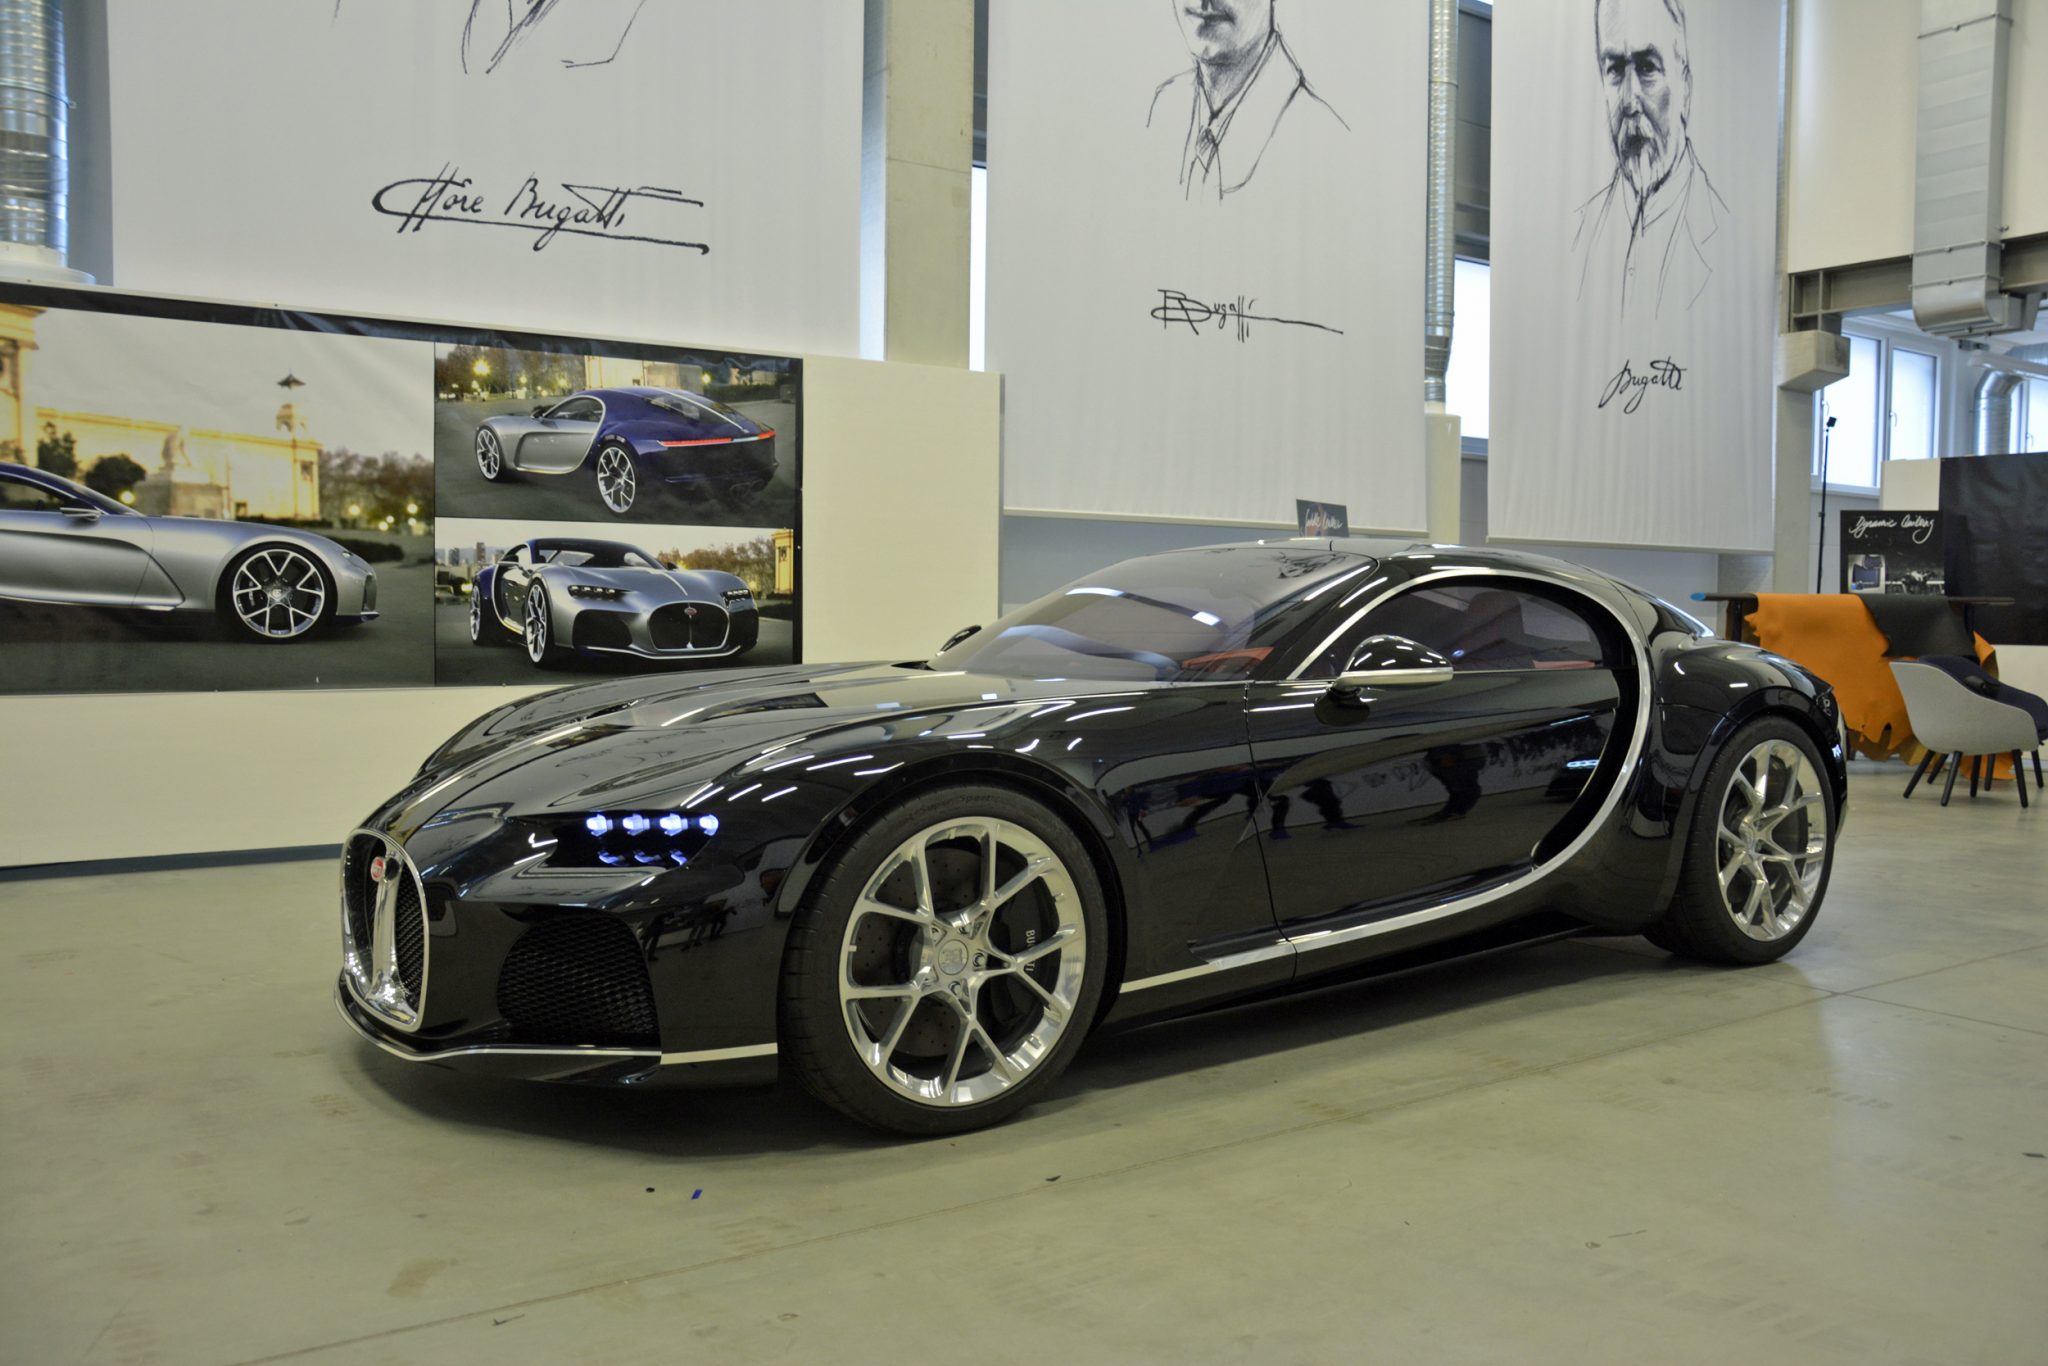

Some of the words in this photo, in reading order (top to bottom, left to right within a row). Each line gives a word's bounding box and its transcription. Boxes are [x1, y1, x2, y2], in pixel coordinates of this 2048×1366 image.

[505, 172, 710, 254] Bugatti
[1598, 356, 1687, 414] Bugatti
[1025, 929, 1036, 972] BUTI
